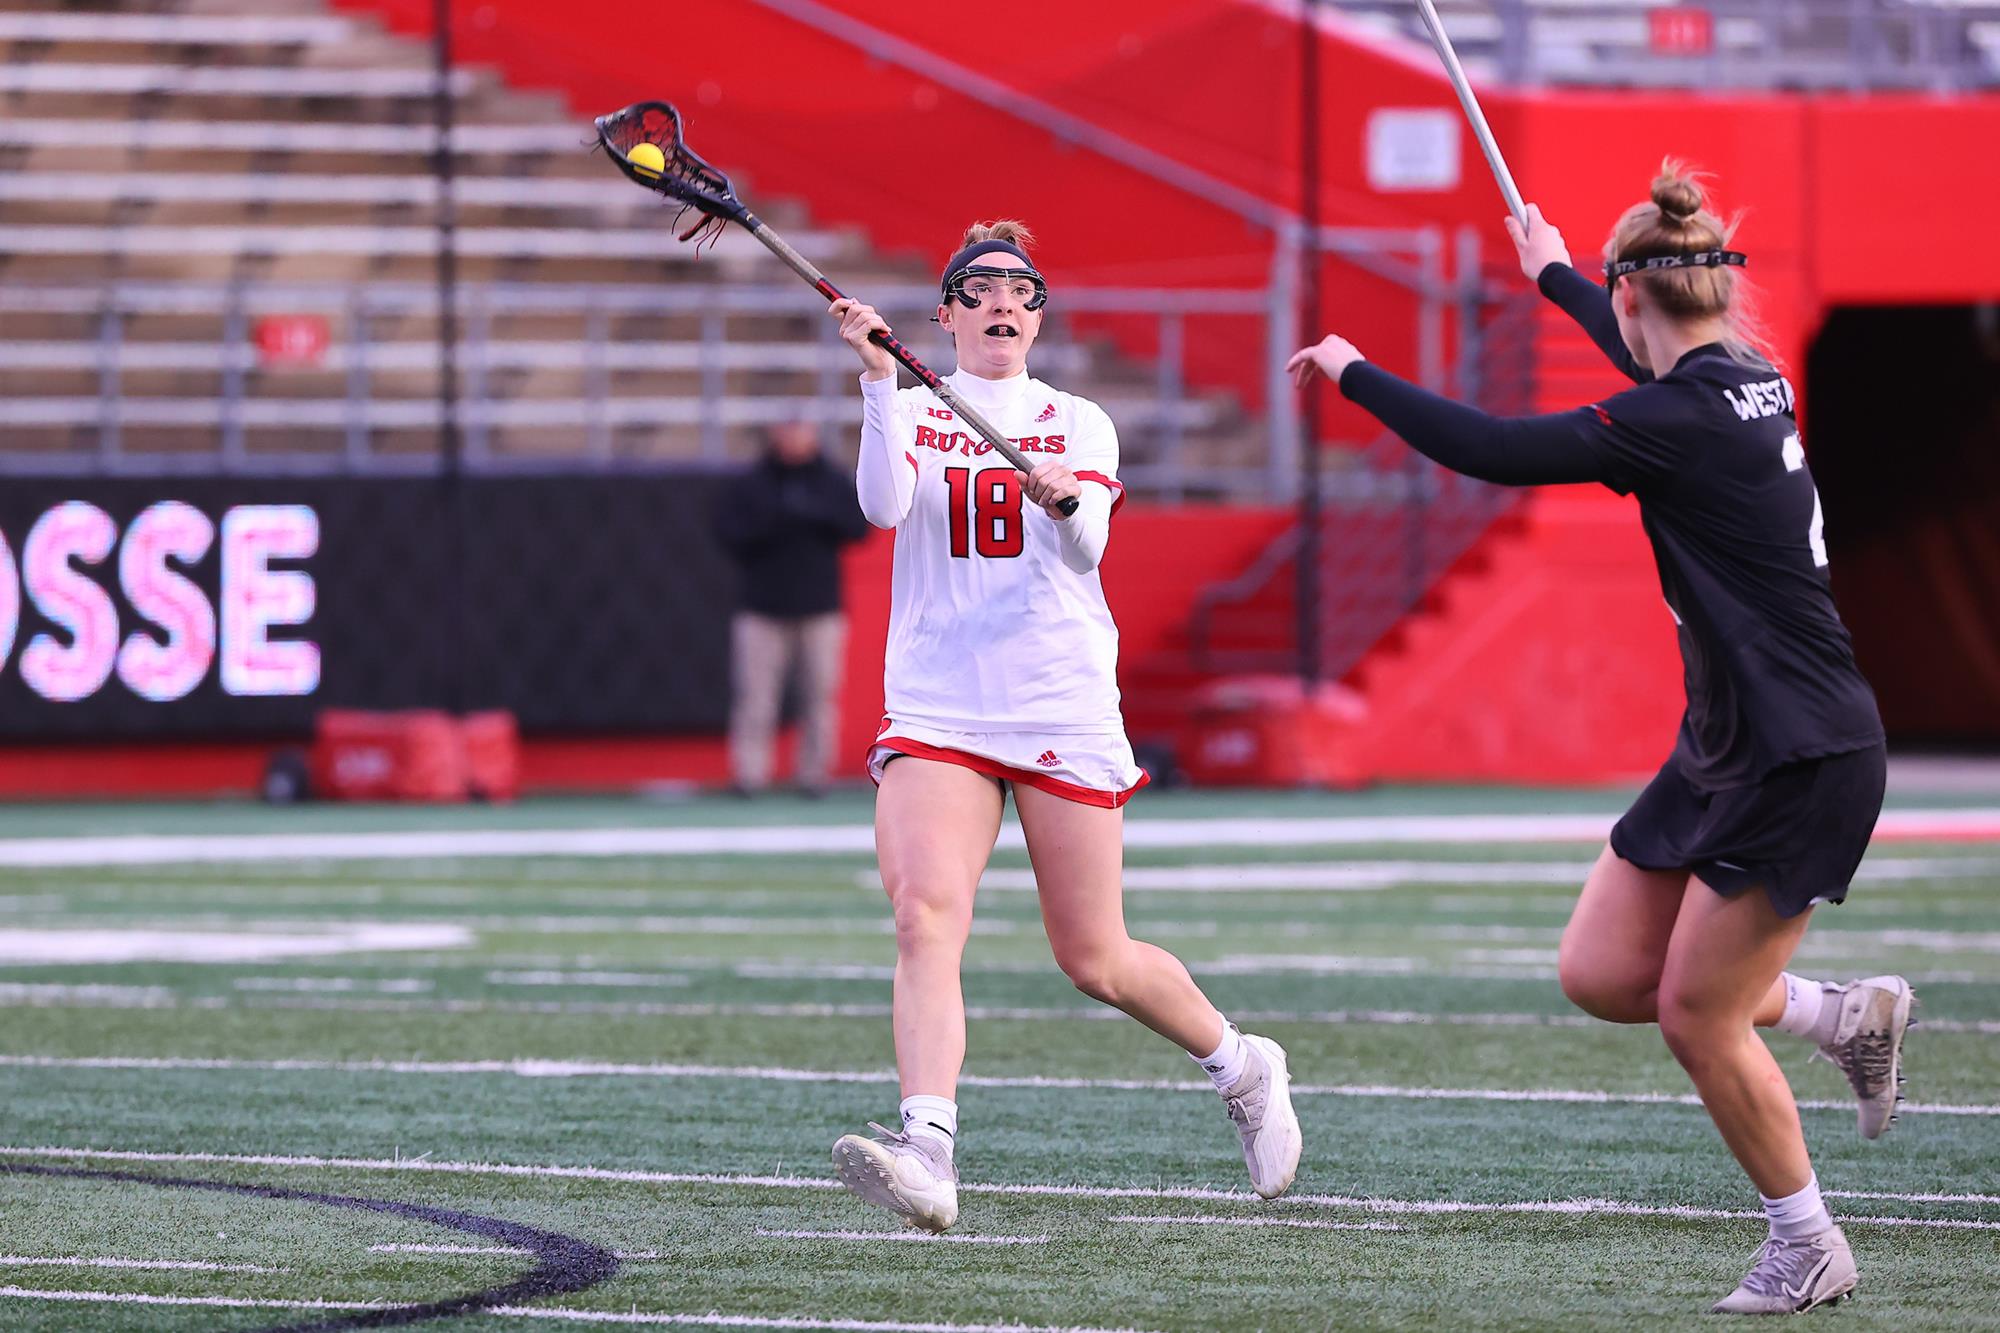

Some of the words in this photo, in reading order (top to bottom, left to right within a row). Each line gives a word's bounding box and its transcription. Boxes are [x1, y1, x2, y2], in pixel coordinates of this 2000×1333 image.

[1646, 255, 1683, 269] STX
[915, 425, 1066, 456] RUTGRS
[944, 466, 1024, 558] 18
[0, 500, 320, 700] SSE
